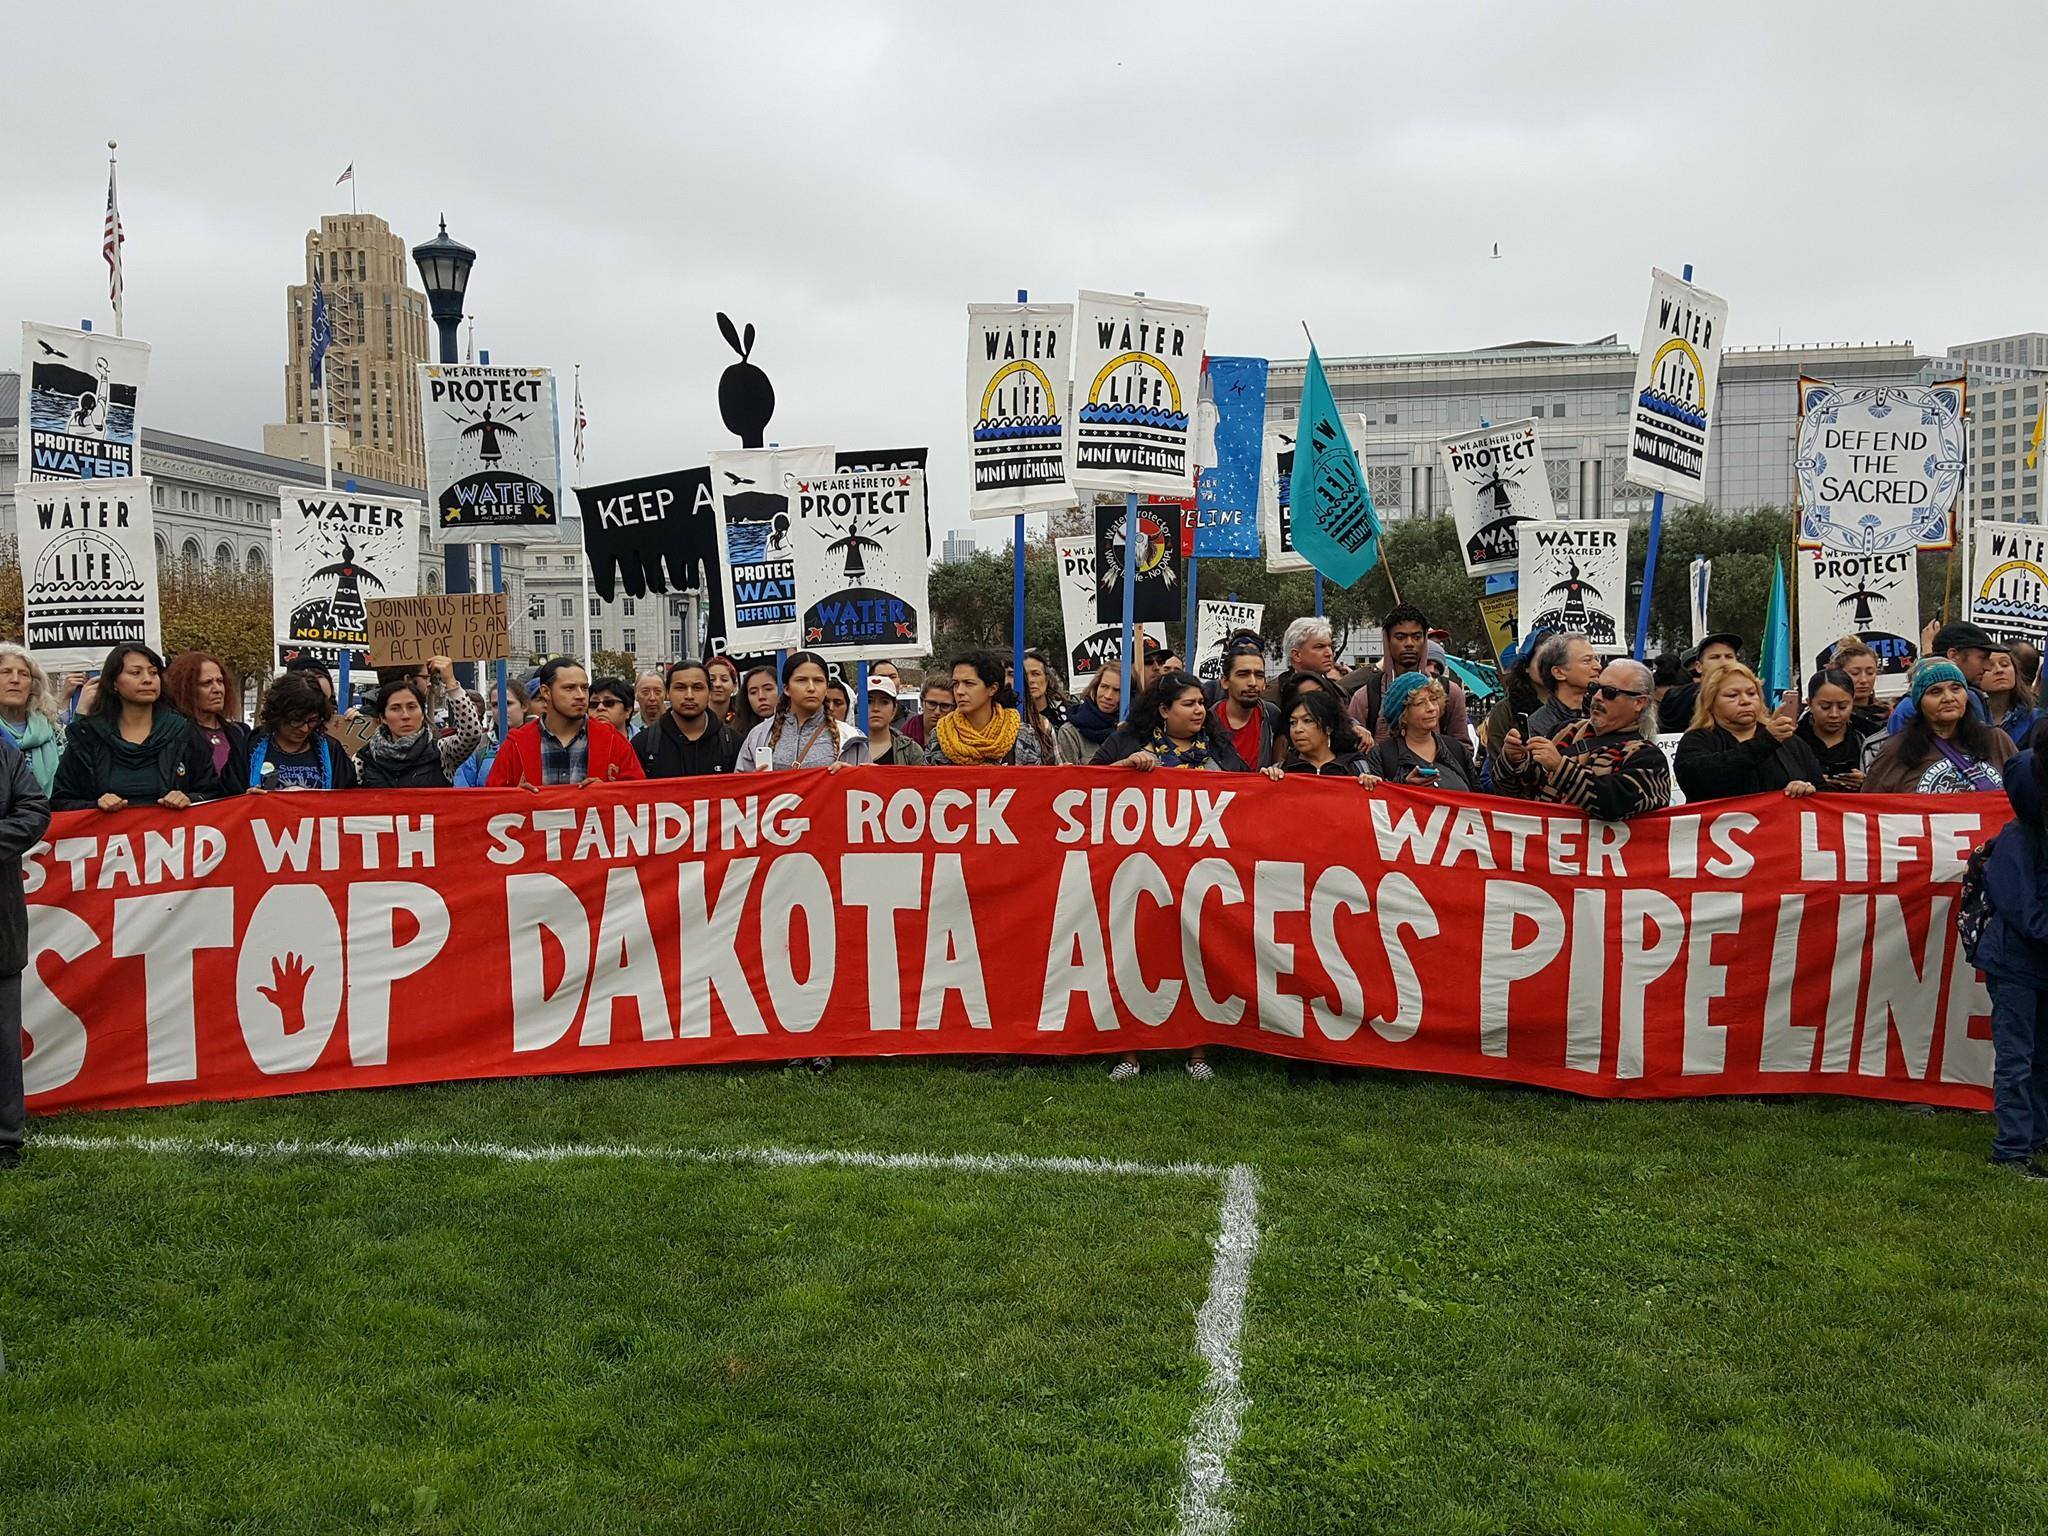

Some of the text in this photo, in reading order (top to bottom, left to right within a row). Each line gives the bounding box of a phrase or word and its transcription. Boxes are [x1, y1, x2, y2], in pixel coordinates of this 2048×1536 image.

[1658, 298, 1712, 350] WATER
[985, 330, 1056, 360] WATER
[1097, 322, 1184, 356] WATER
[1134, 363, 1142, 375] IS
[1678, 351, 1684, 364] IS
[443, 367, 527, 377] WE ARE HERE TO
[1018, 372, 1026, 385] IS
[1660, 361, 1694, 401] LIFE
[431, 380, 541, 402] PROTECT
[998, 386, 1039, 416] LIFE
[1110, 376, 1162, 406] LIFE
[34, 432, 129, 460] PROTECT THE
[1459, 432, 1522, 451] WE ARE HERE TO
[1825, 429, 1927, 451] DEFEND
[35, 448, 128, 478] WATER
[1452, 439, 1535, 472] PROTECT
[1850, 455, 1898, 474] THE
[454, 482, 544, 506] WATER
[812, 477, 895, 491] WE ARE HERE TO
[1820, 476, 1928, 504] SACRED
[37, 501, 129, 529] WATER
[298, 499, 404, 529] WATER
[474, 505, 522, 515] IS LIFE
[597, 483, 715, 529] KEEP A
[801, 490, 909, 518] PROTECT
[318, 521, 384, 536] IS SACRED
[1137, 510, 1171, 537] rotector
[78, 540, 88, 552] IS
[1495, 545, 1505, 553] IS
[1536, 530, 1617, 548] WATER
[55, 553, 111, 581] LIFE
[1104, 549, 1121, 574] Water
[1148, 568, 1161, 579] No
[1158, 548, 1173, 570] DAPL
[1814, 553, 1907, 579] PROTECT
[2020, 568, 2026, 579] IS
[1999, 578, 2041, 603] LIFE
[370, 594, 505, 618] JOINING US HERE
[737, 606, 780, 622] DEFEND
[816, 600, 906, 625] WATER
[1207, 603, 1255, 619] WATER
[375, 616, 507, 638] AND NOW IS AN
[835, 623, 884, 635] IS LIFE
[1222, 616, 1246, 624] SACRED
[29, 623, 63, 643] MNÍ
[297, 628, 319, 638] NO
[311, 650, 353, 662] IS LIE
[391, 633, 508, 661] ACT OF LOVE
[22, 788, 1236, 894] STAND WITH STANDING ROCK SIOUX
[1369, 799, 1981, 884] WATER IS LIFE
[21, 850, 1994, 1096] STOP DAKOTA ACCESS PIPELINE
